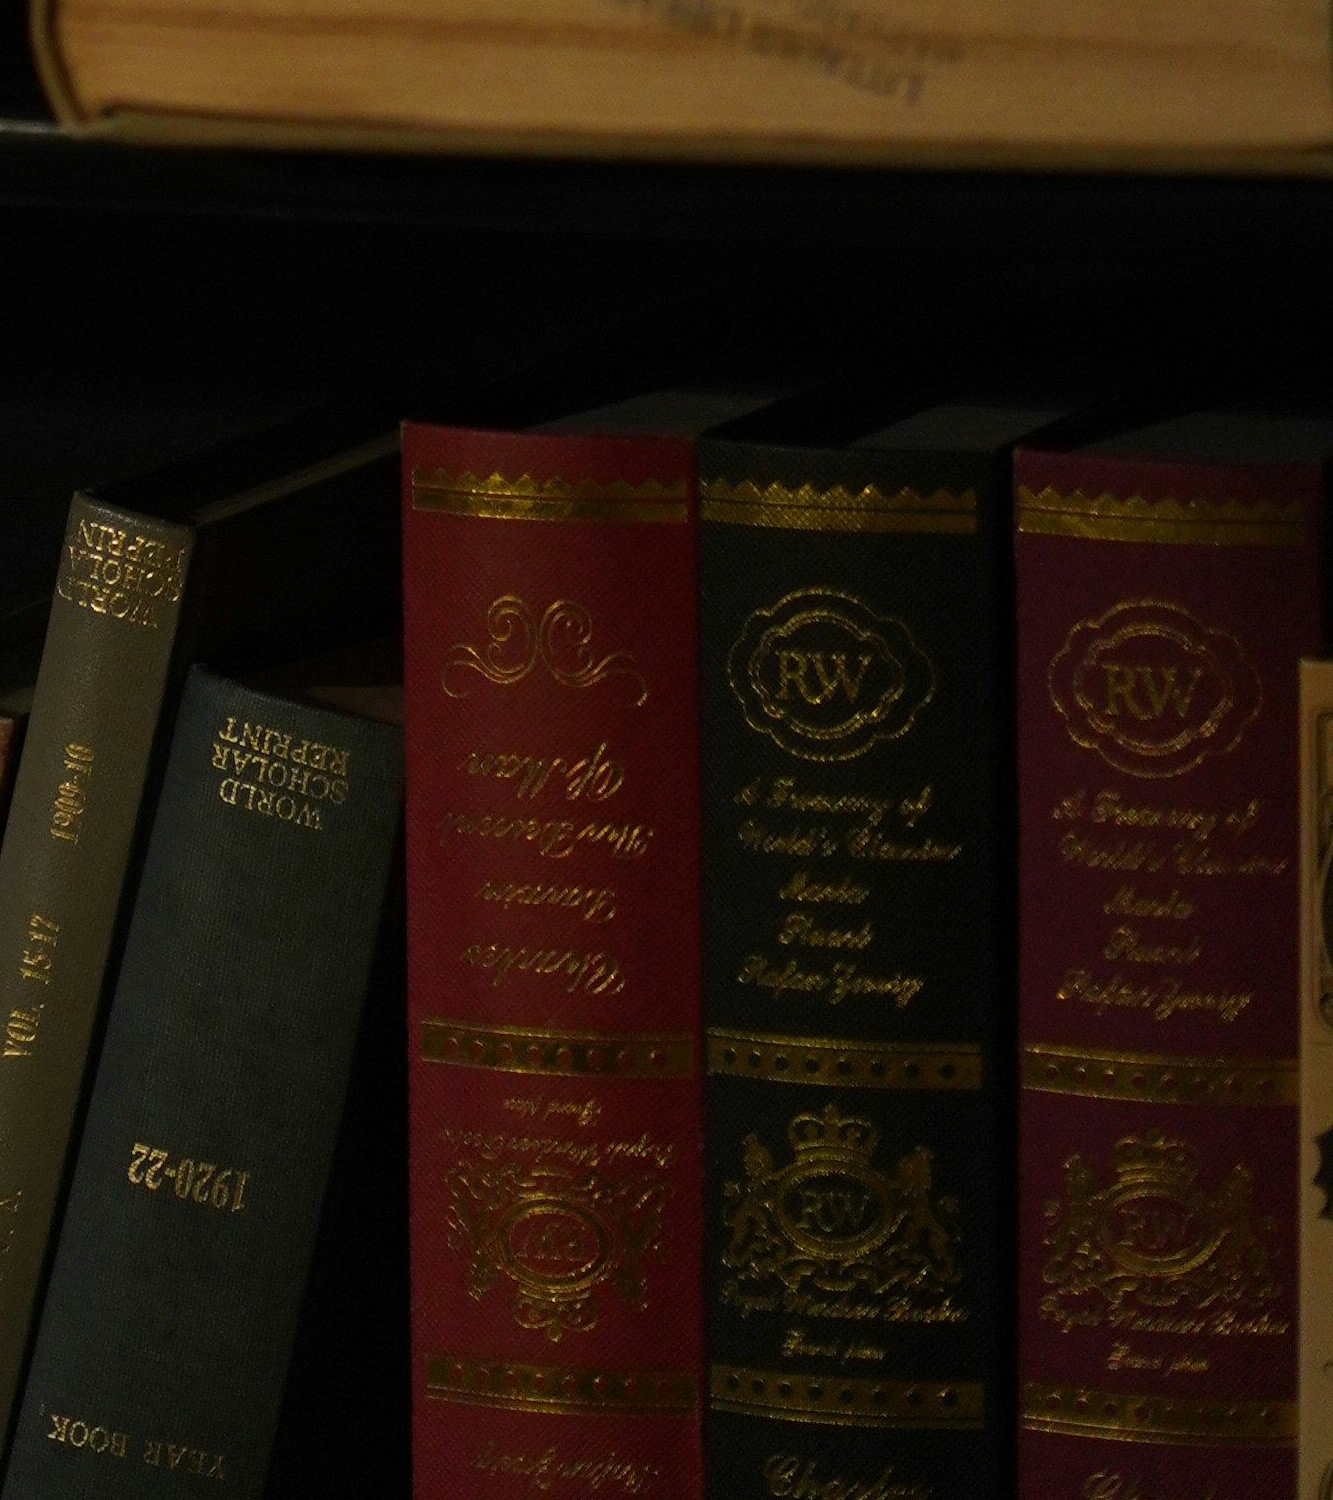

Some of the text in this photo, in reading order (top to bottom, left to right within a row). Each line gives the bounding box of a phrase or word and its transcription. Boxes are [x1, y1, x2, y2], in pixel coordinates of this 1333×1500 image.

[67, 544, 185, 602] SCHOLA
[77, 516, 186, 572] REPRIN
[57, 575, 158, 629] WORLD
[774, 649, 874, 708] RW
[1100, 662, 1201, 720] RW
[211, 741, 350, 806] SCHOLAR
[217, 716, 350, 777] REPRINT
[455, 751, 565, 800] Man
[49, 741, 95, 845] 1909-10
[218, 777, 323, 832] WORLD
[437, 811, 575, 860] Descent
[473, 878, 617, 924] Darwin
[459, 943, 626, 998] Charles
[1, 1000, 44, 1061] VOL.
[126, 1140, 252, 1214] 1920-22
[797, 1191, 870, 1233] RW
[45, 1412, 228, 1482] YEAR BOOK
